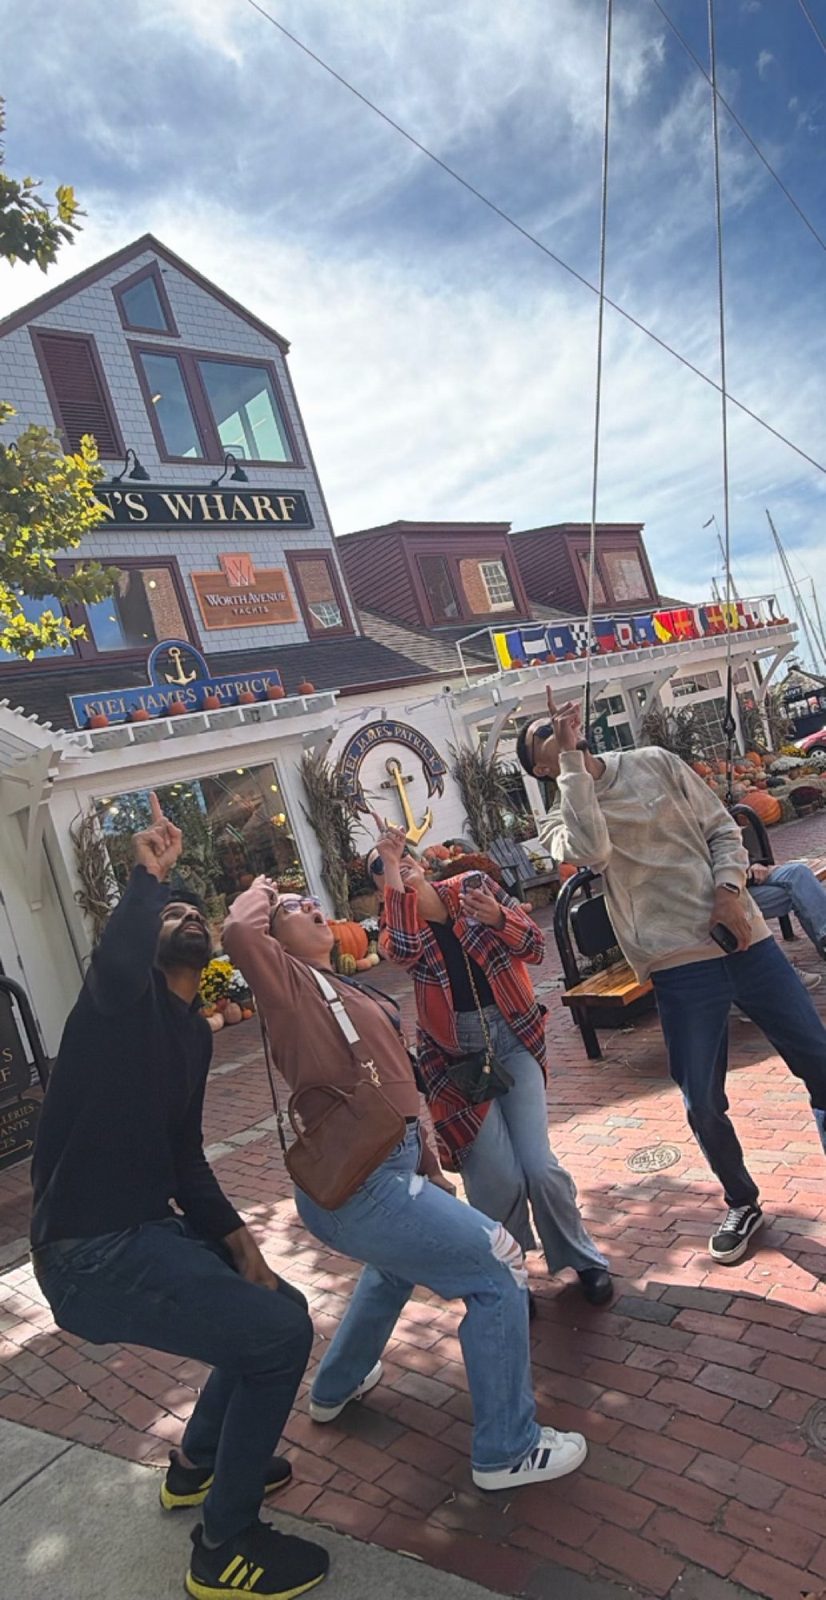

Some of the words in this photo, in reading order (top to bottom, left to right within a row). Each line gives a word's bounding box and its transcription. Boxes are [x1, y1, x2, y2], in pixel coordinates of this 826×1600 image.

[158, 493, 298, 521] WHARF
[232, 606, 270, 616] YACHTS
[84, 697, 130, 718] KIEL
[138, 687, 198, 710] JAMES
[202, 677, 273, 701] PATRICK
[393, 726, 443, 764] PATRICK
